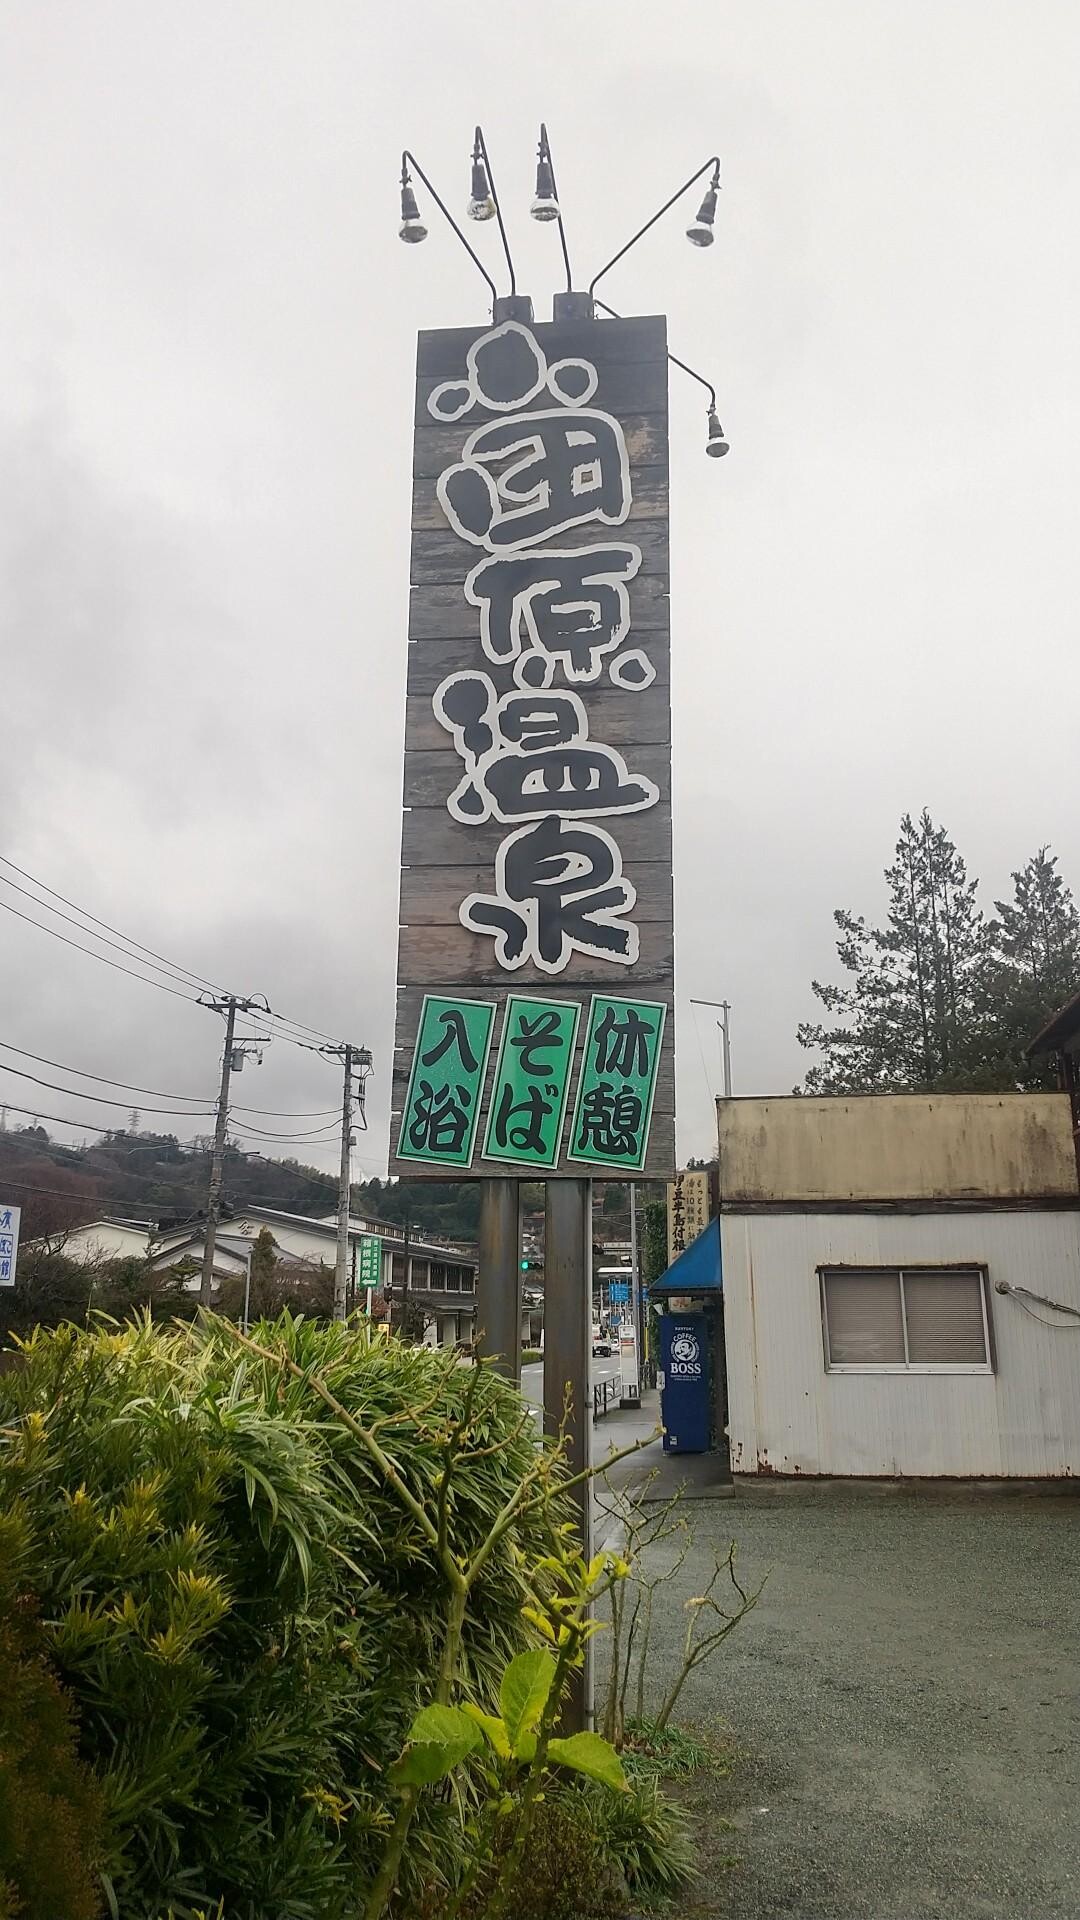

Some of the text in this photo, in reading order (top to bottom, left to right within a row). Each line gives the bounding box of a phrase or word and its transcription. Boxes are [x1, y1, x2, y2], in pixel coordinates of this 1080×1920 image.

[428, 321, 660, 972] 小田原温泉
[408, 1009, 479, 1154] 入浴
[495, 1011, 566, 1155] そば
[578, 1006, 655, 1156] 休憩
[670, 1362, 702, 1375] BOSS
[673, 1332, 697, 1343] COFFEE
